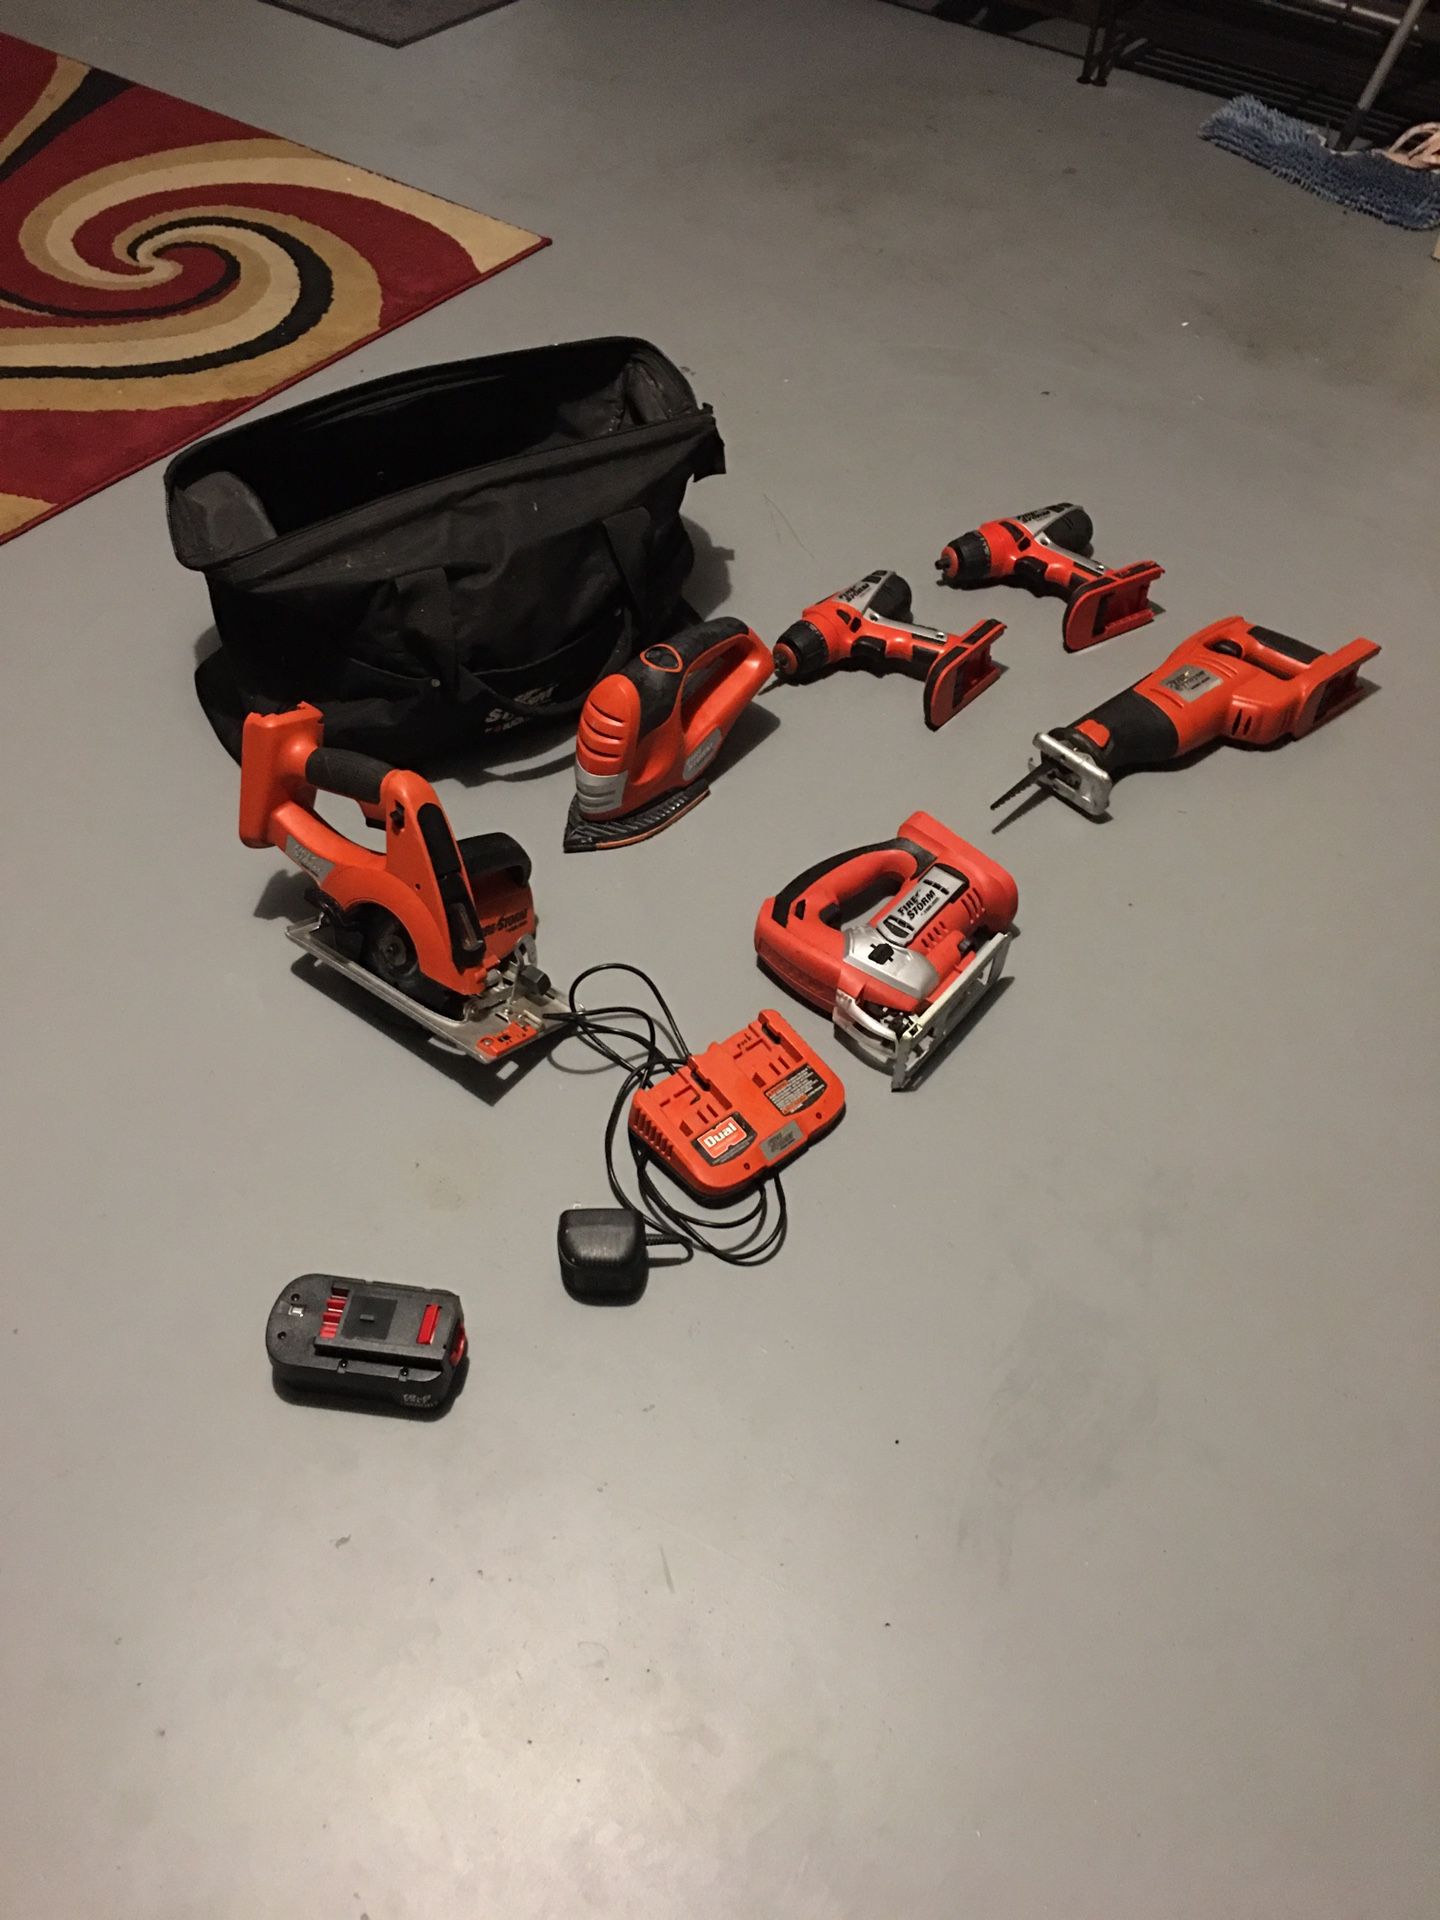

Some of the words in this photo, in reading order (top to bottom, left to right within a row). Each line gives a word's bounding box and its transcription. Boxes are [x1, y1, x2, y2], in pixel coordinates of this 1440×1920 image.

[897, 893, 919, 916] FIRE
[907, 890, 936, 920] STORM
[703, 1122, 737, 1148] Dual
